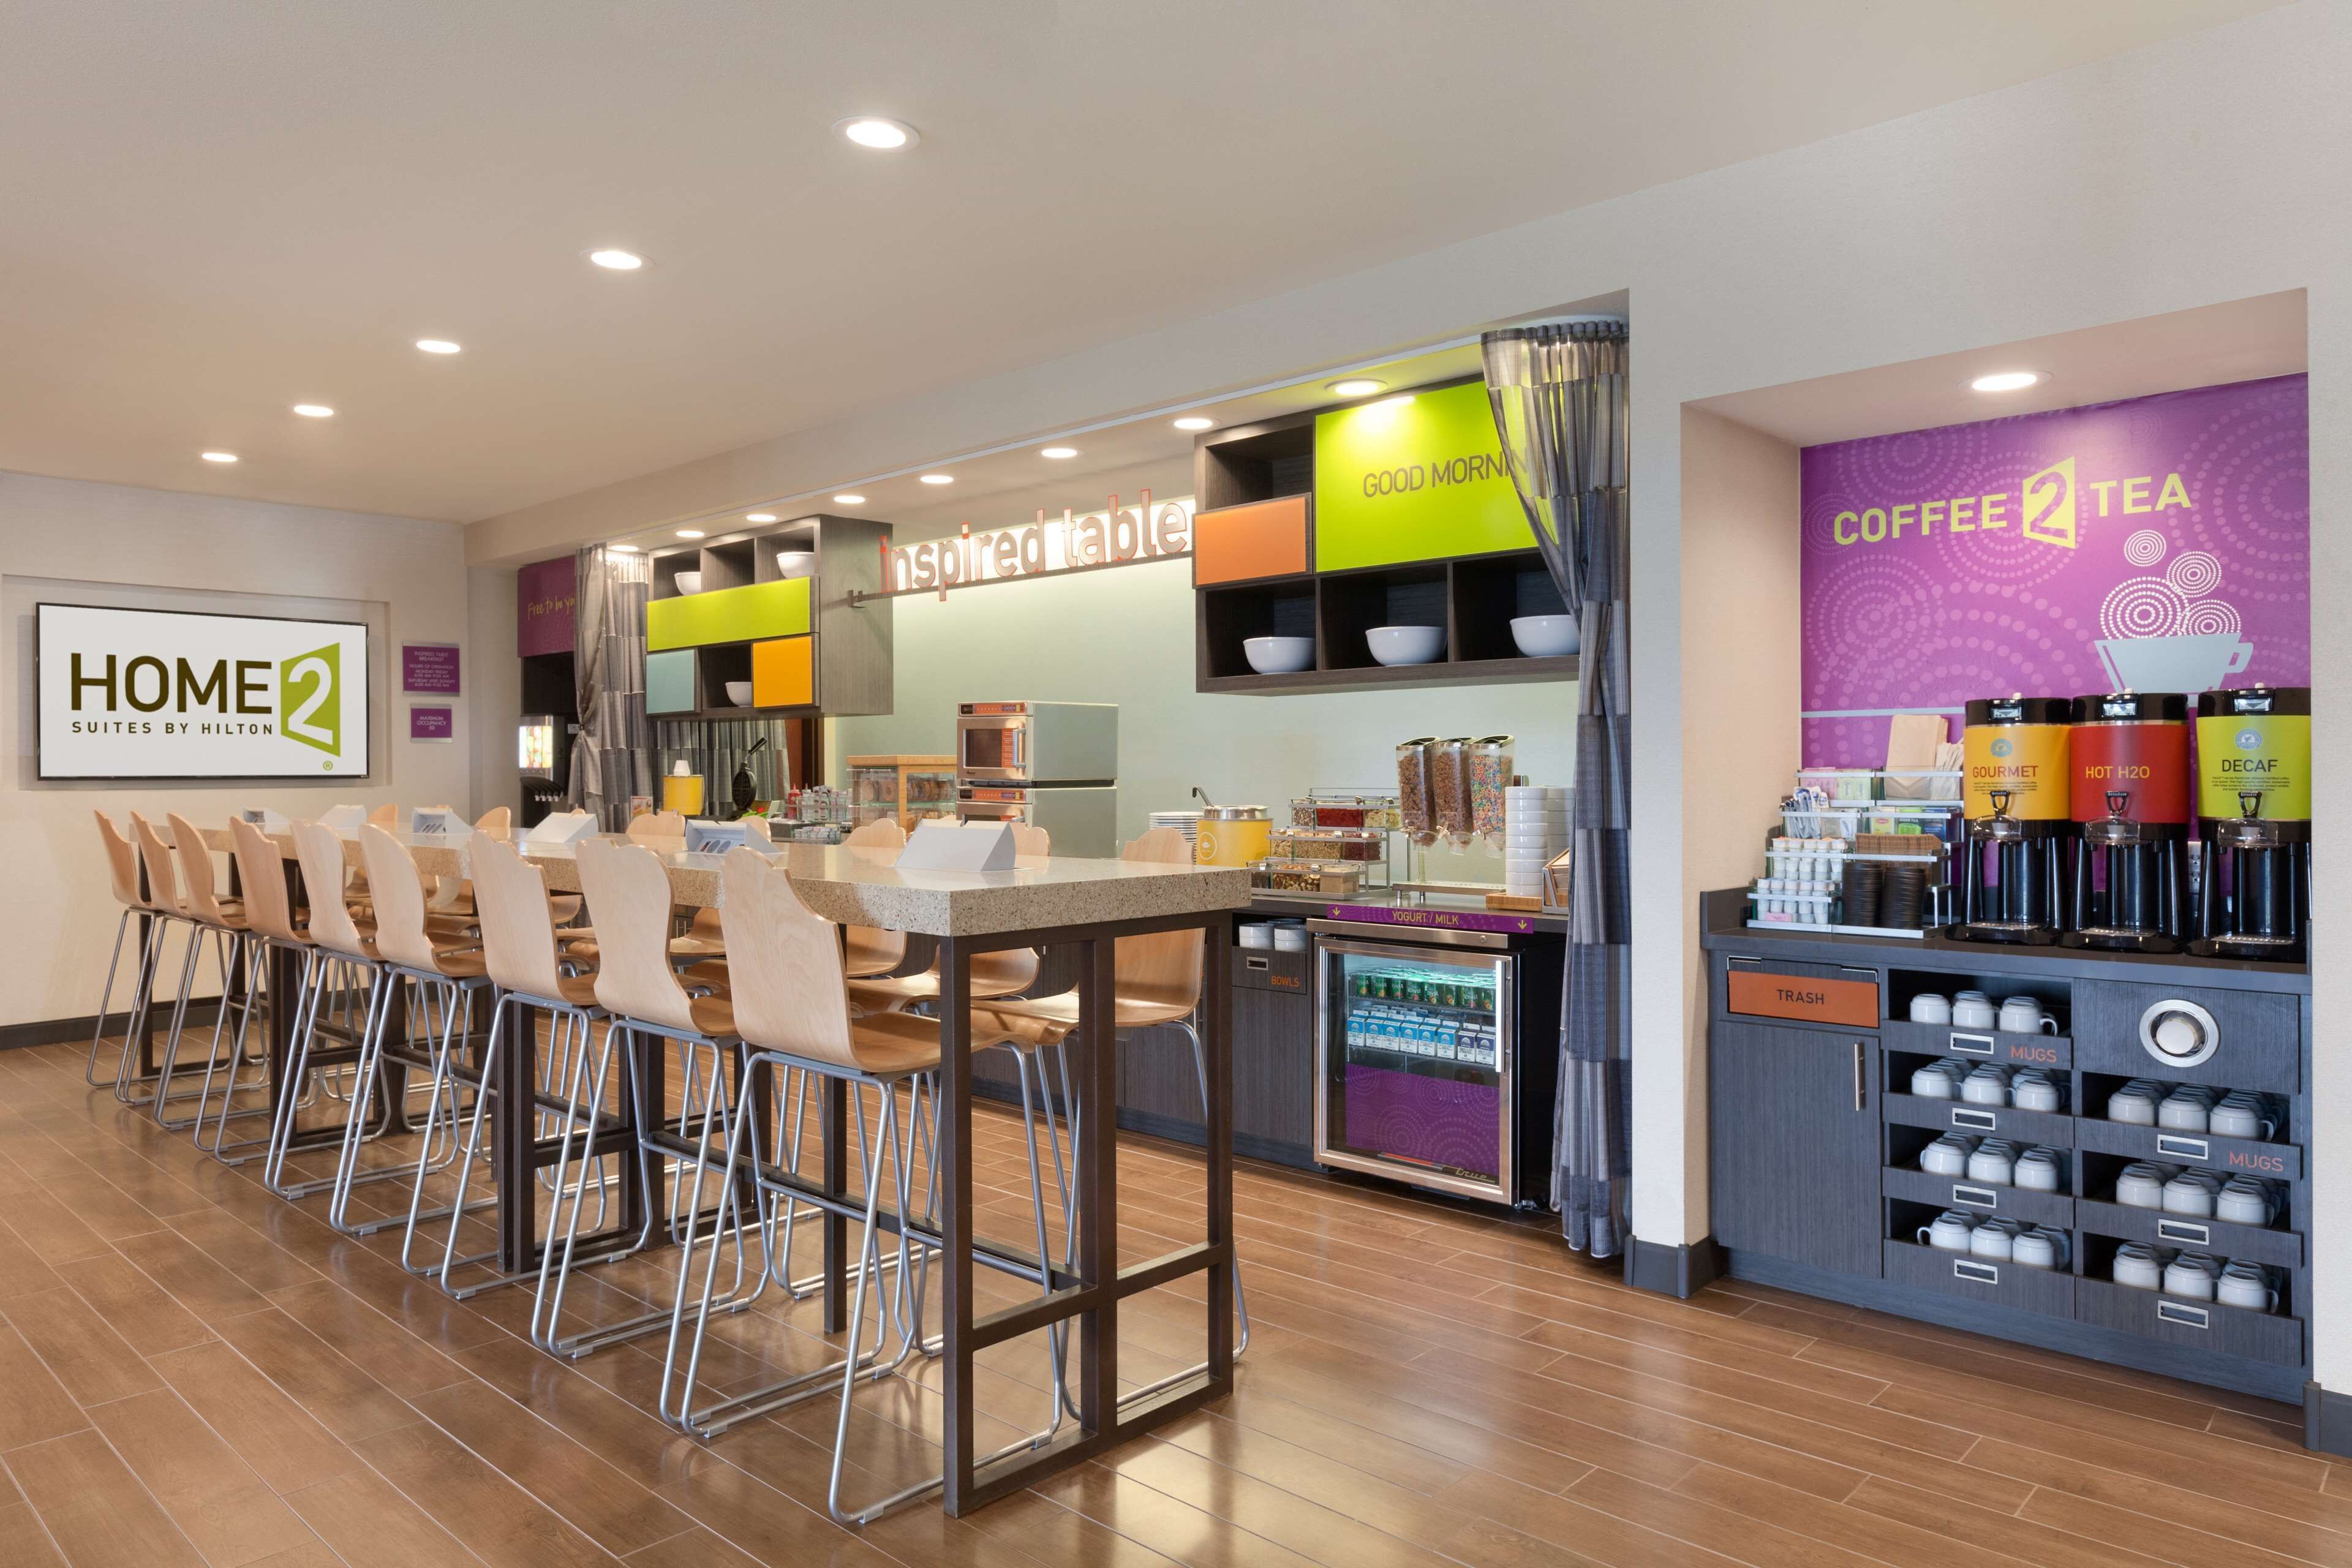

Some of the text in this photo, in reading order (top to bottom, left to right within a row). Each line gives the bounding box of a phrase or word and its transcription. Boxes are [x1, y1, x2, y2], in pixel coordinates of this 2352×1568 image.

[1363, 464, 1425, 498] GOOD
[1834, 471, 2192, 545] COFFEE 2 TEA
[879, 488, 1188, 602] inspired table
[527, 602, 544, 621] Free
[70, 652, 334, 746] HOME 2
[72, 721, 273, 735] SUITES BY HILTON
[1972, 765, 2039, 778] GOURMET
[2085, 765, 2150, 779] HOT H2O
[2222, 759, 2278, 772] DECAF
[1392, 911, 1459, 925] YOGURT / MILK
[1271, 975, 1300, 987] BOWLS
[1776, 989, 1825, 1005] TRASH
[2010, 1044, 2057, 1063] MUGS
[2228, 1150, 2284, 1172] MUGS
[1455, 1166, 1496, 1183] true
